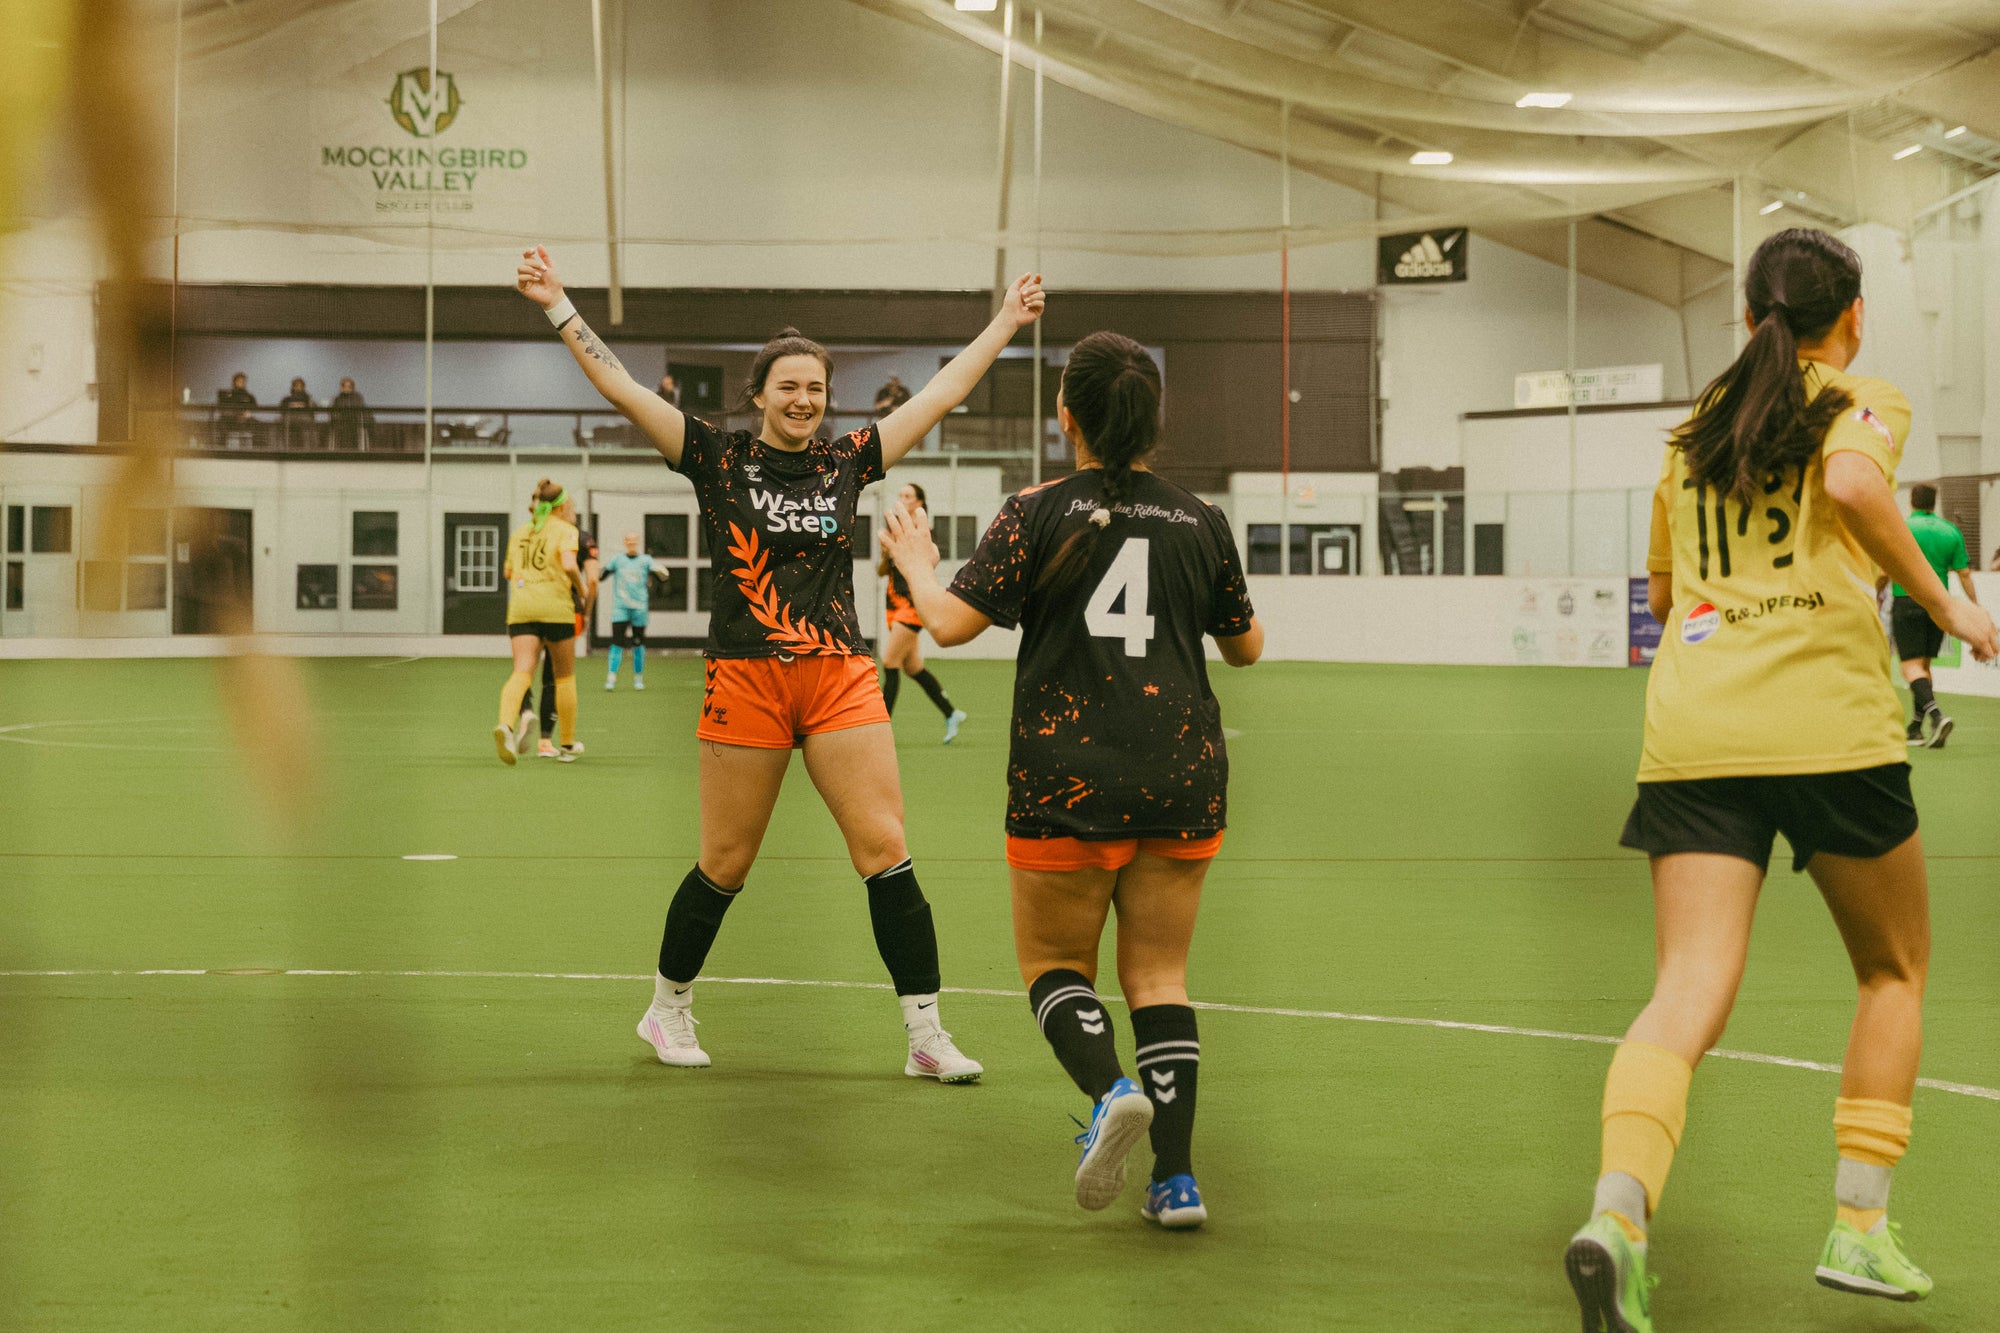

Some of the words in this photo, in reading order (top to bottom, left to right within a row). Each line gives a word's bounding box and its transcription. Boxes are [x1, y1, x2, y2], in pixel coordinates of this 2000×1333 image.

[321, 147, 528, 169] MOCKINGBIRD
[372, 170, 477, 190] VALLEY
[1394, 259, 1454, 278] adidas
[749, 488, 837, 511] Water
[766, 510, 838, 539] Step
[1128, 503, 1171, 518] Ribbon
[1168, 508, 1199, 526] Beer
[519, 537, 548, 571] 16
[1084, 537, 1155, 658] 4
